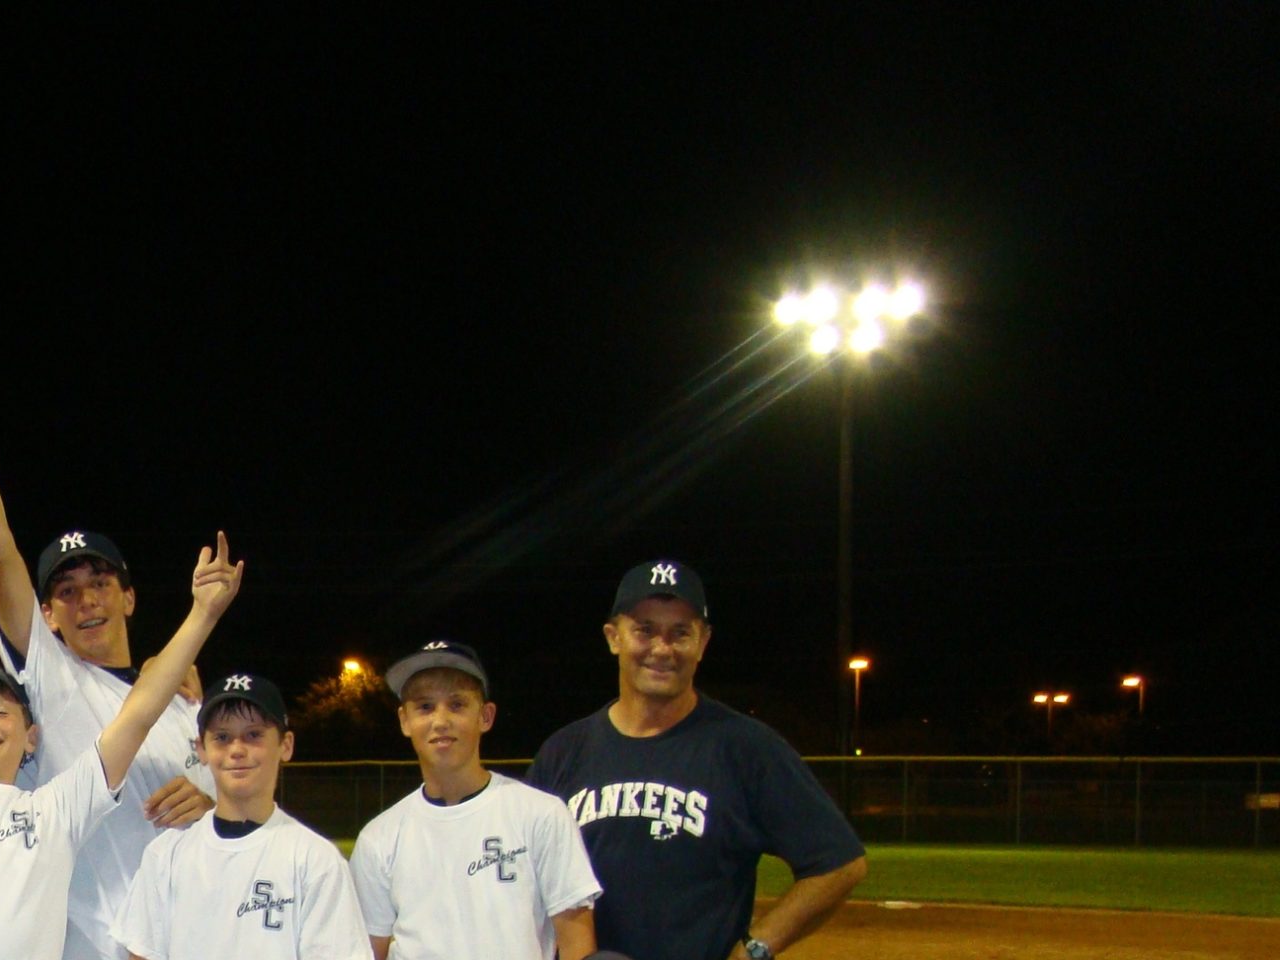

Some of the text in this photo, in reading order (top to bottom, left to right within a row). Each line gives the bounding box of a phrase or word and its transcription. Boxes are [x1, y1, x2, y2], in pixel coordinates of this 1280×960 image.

[60, 531, 87, 552] NY
[650, 563, 677, 586] NY
[223, 674, 253, 691] NY
